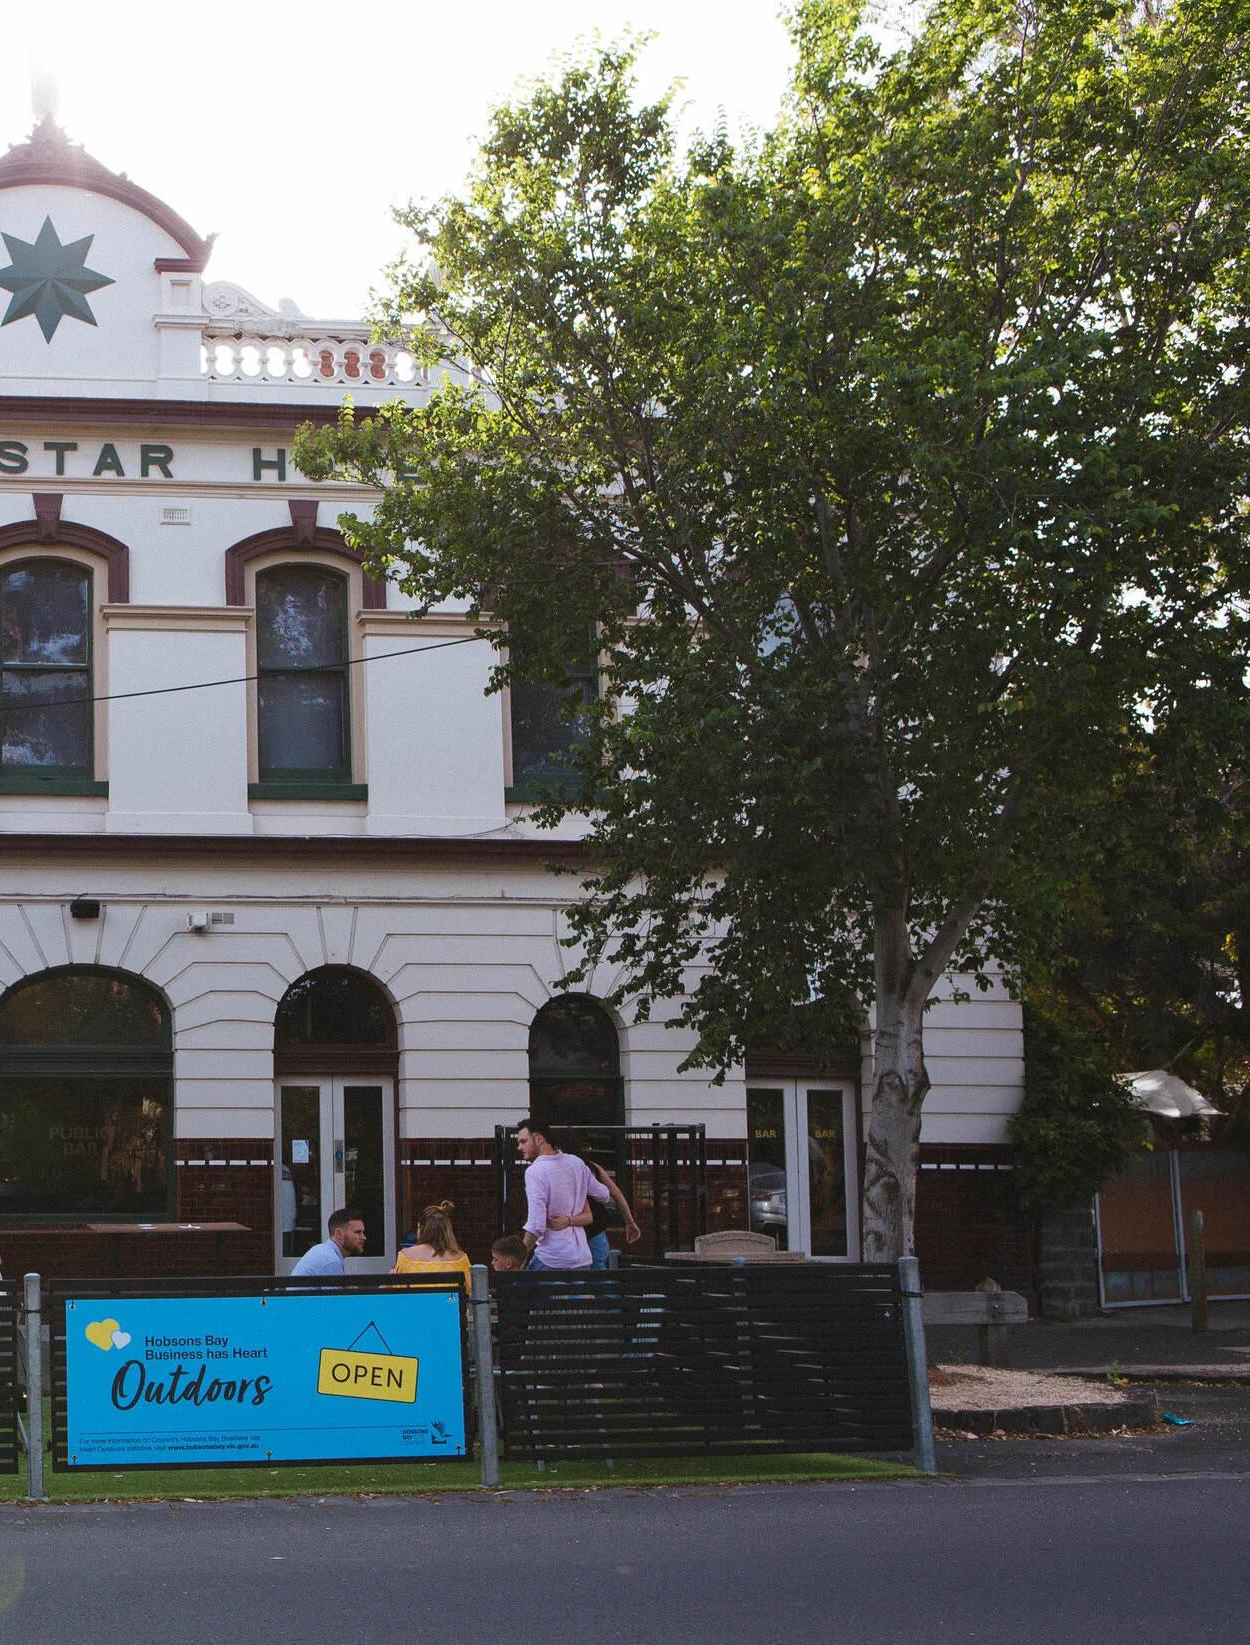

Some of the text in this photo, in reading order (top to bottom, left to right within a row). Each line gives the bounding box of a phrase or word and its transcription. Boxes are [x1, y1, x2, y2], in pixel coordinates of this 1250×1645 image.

[755, 1129, 777, 1139] BAR
[814, 1129, 836, 1139] BAR
[145, 1335, 229, 1348] Hobsons Bay
[145, 1348, 268, 1361] Business has Heart
[331, 1363, 404, 1389] OPEN
[111, 1360, 274, 1411] Outdoors
[167, 1443, 260, 1451] www.hobsonsbay.vic.gov.au
